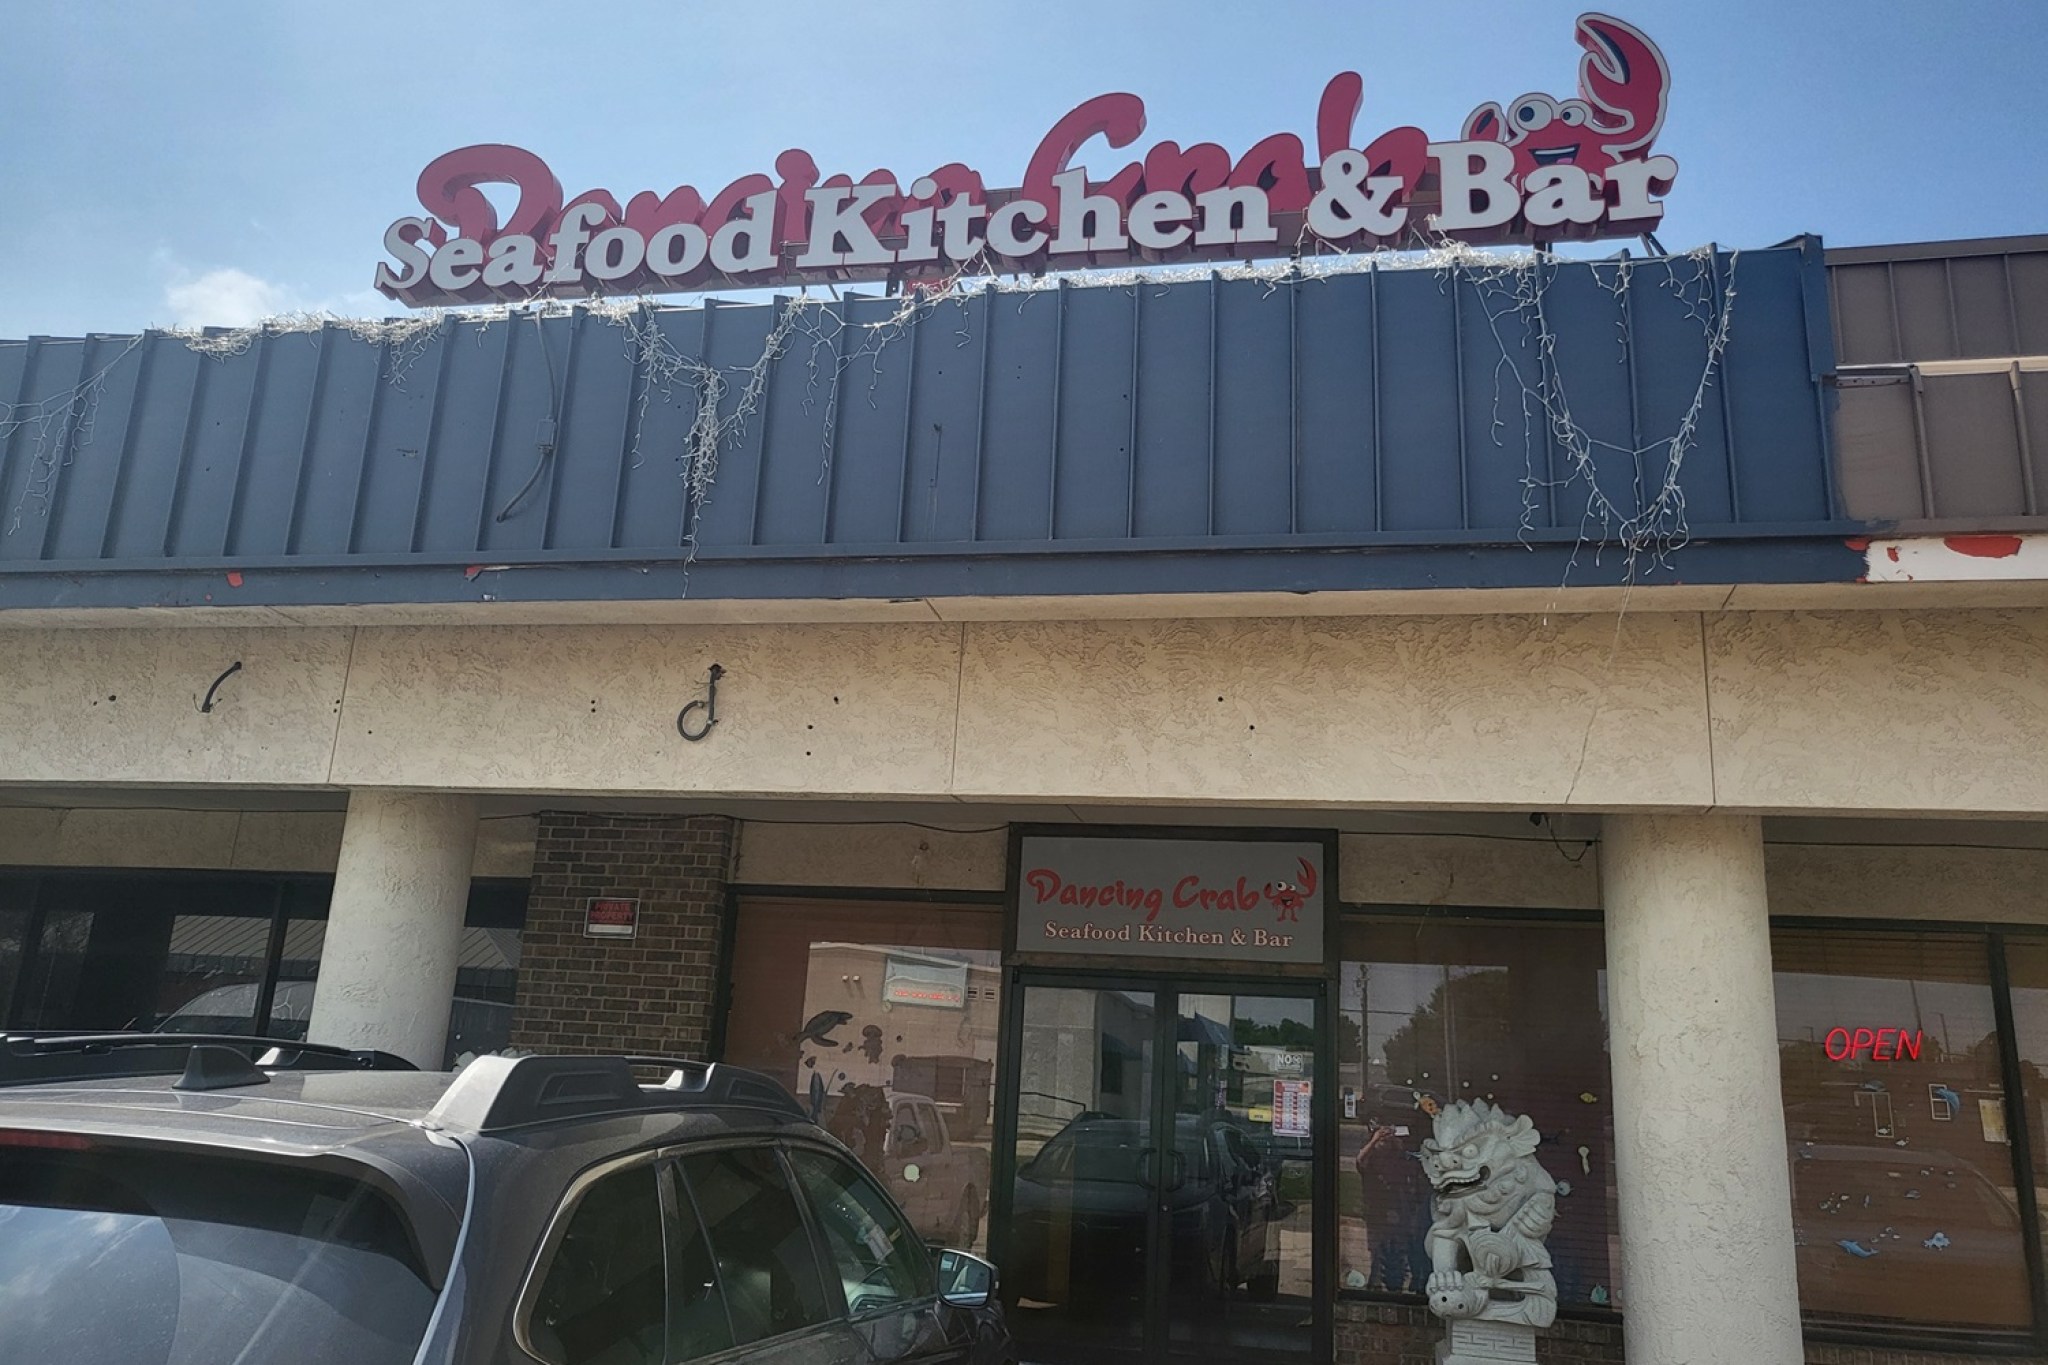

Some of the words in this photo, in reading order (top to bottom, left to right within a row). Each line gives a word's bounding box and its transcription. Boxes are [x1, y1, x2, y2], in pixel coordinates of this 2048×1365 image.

[374, 189, 779, 290] Seafood
[795, 166, 1278, 268] Kitchen
[1307, 148, 1409, 239] &
[1426, 139, 1679, 232] Bar
[594, 902, 632, 912] PRIVATE
[1026, 868, 1163, 922] Dancing
[1172, 875, 1260, 911] Crab
[590, 911, 634, 921] PROPERTY
[1045, 920, 1131, 942] Seafood
[1138, 924, 1224, 945] Kitchen
[1230, 927, 1247, 946] &
[1253, 928, 1294, 948] Bar
[1824, 1026, 1922, 1062] OPEN
